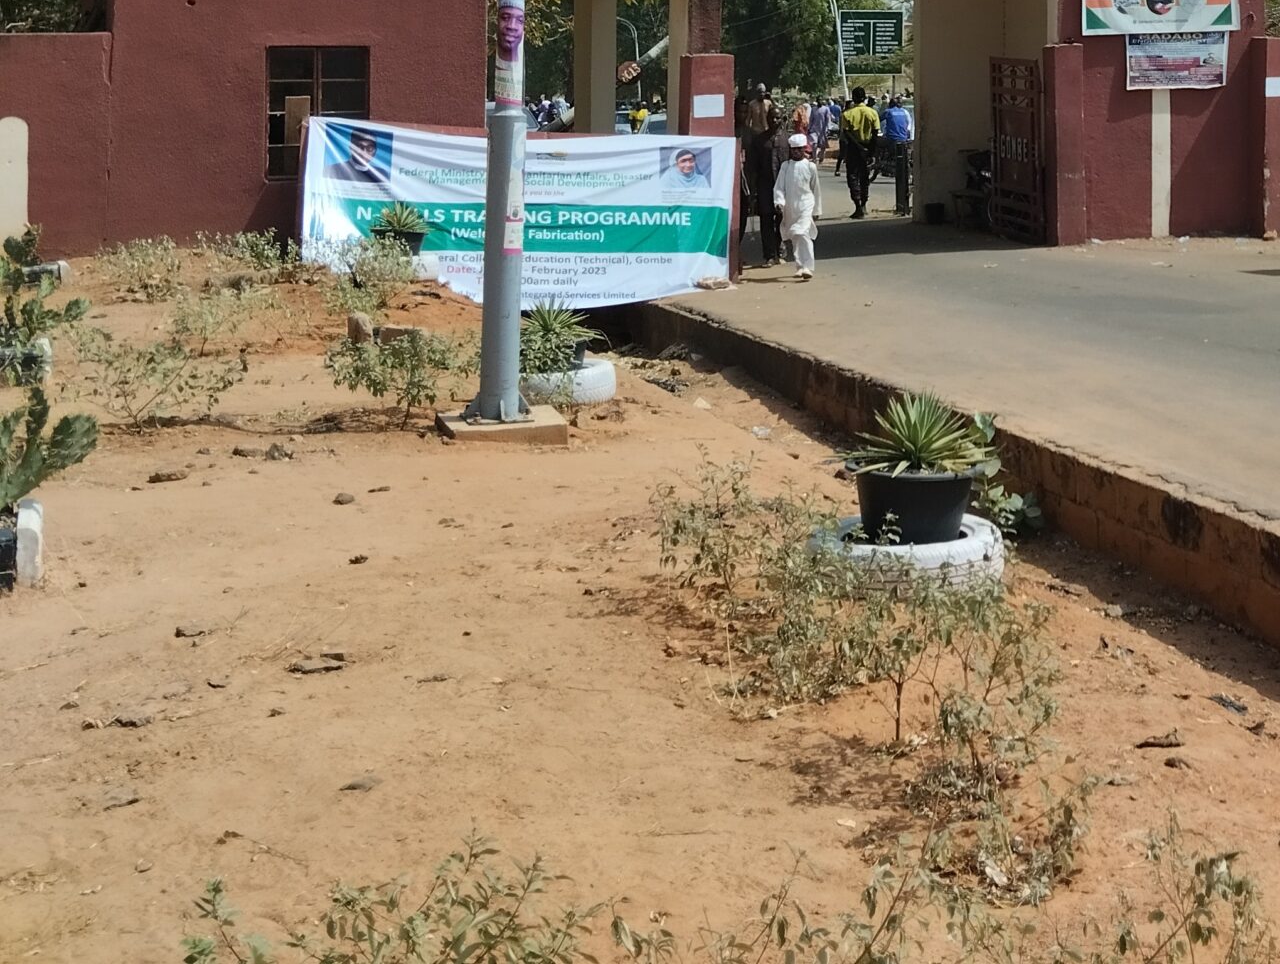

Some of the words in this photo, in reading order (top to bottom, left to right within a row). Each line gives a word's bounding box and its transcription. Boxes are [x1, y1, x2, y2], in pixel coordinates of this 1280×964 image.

[399, 167, 438, 177] Federal
[441, 167, 485, 178] Ministry
[526, 171, 572, 180] anitarian
[613, 172, 654, 181] Disaster
[428, 176, 486, 186] Manageme
[524, 178, 555, 187] Social
[557, 179, 625, 189] Development
[558, 210, 692, 226] PROGRAMME
[528, 228, 605, 243] Fabrication)
[574, 254, 632, 266] (Technical),
[635, 254, 673, 265] Gombe
[446, 265, 477, 274] Date:
[531, 265, 579, 277] February
[581, 266, 607, 275] 2023
[552, 276, 579, 287] daily
[564, 291, 601, 300] Services
[603, 290, 637, 301] Limited
